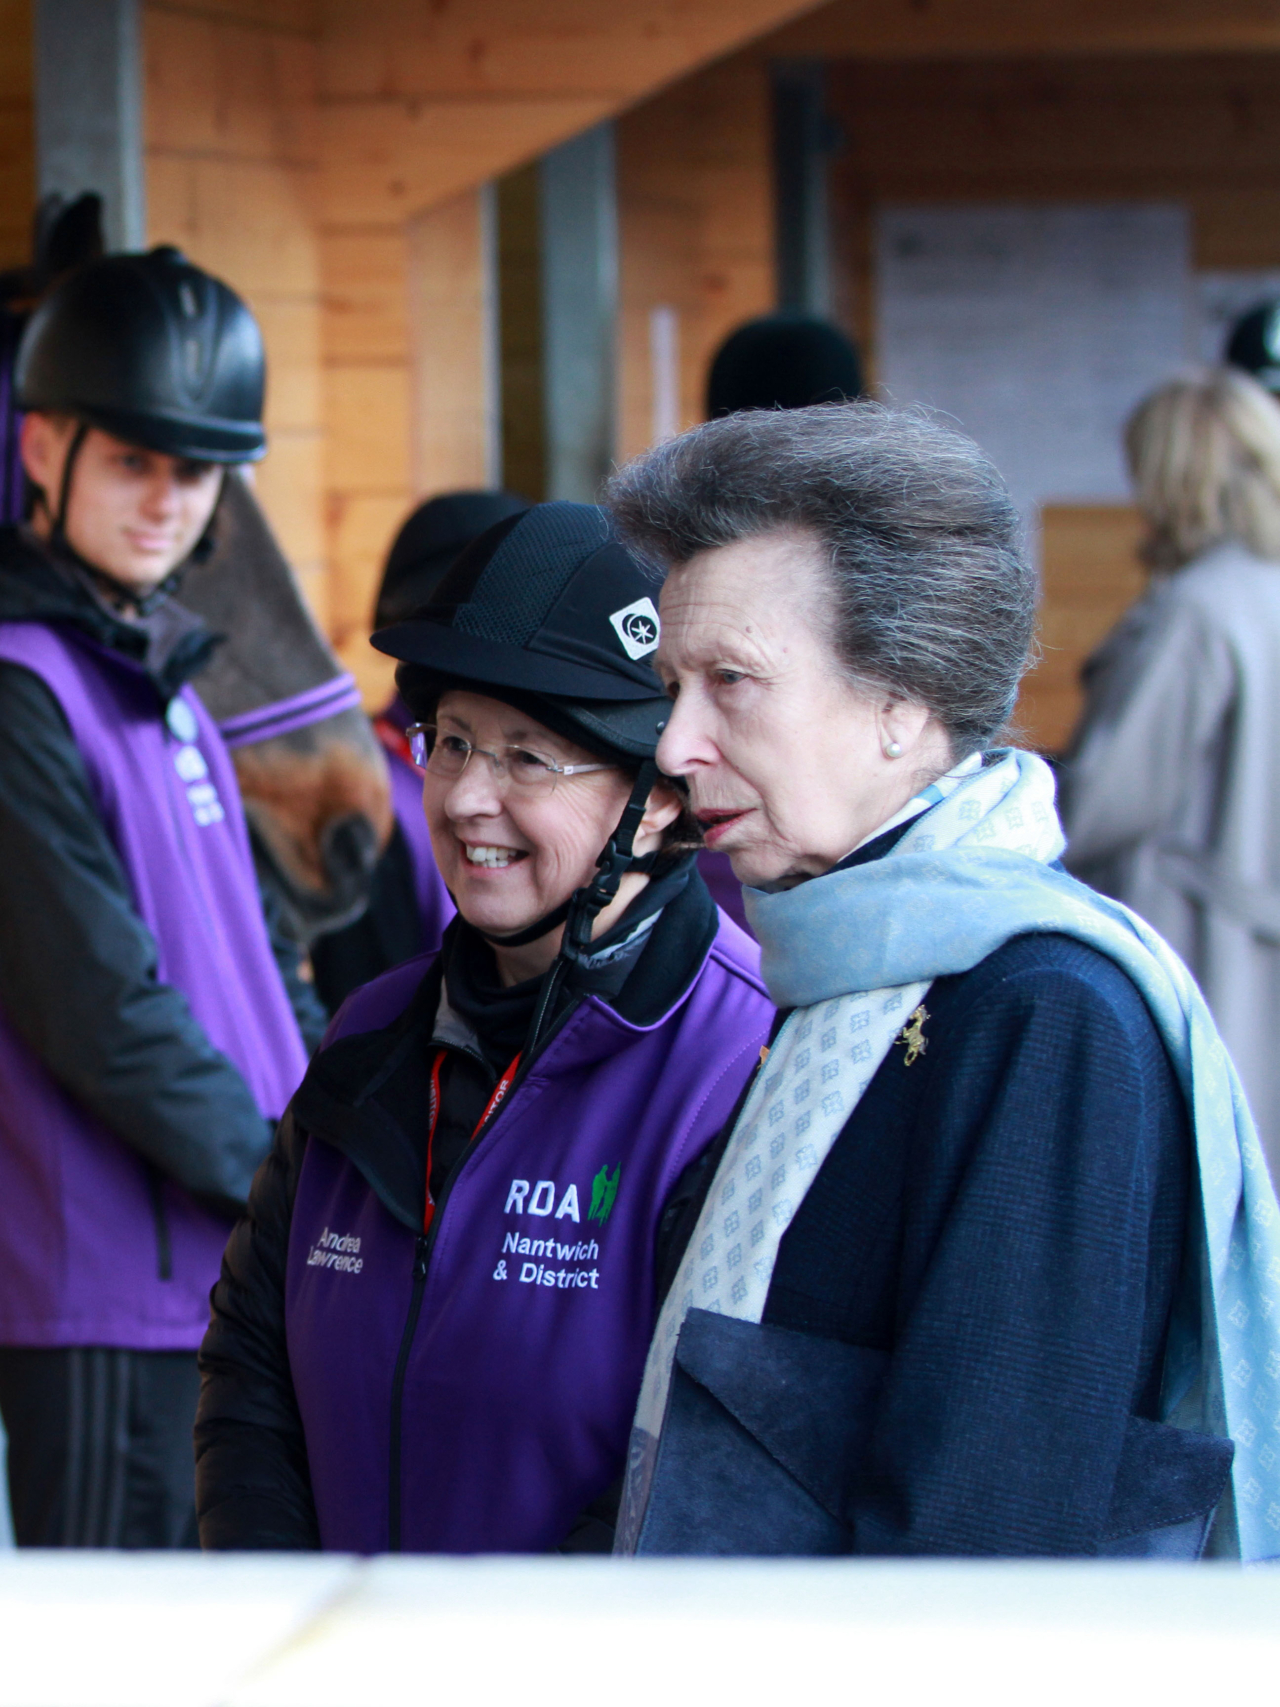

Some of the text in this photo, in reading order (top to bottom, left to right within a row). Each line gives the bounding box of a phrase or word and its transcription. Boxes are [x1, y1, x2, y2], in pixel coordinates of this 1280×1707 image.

[504, 1179, 580, 1223] RDA
[317, 1226, 361, 1253] Andrea
[502, 1232, 599, 1261] Nantwich
[307, 1245, 363, 1274] Lawrence
[493, 1259, 600, 1289] & District
